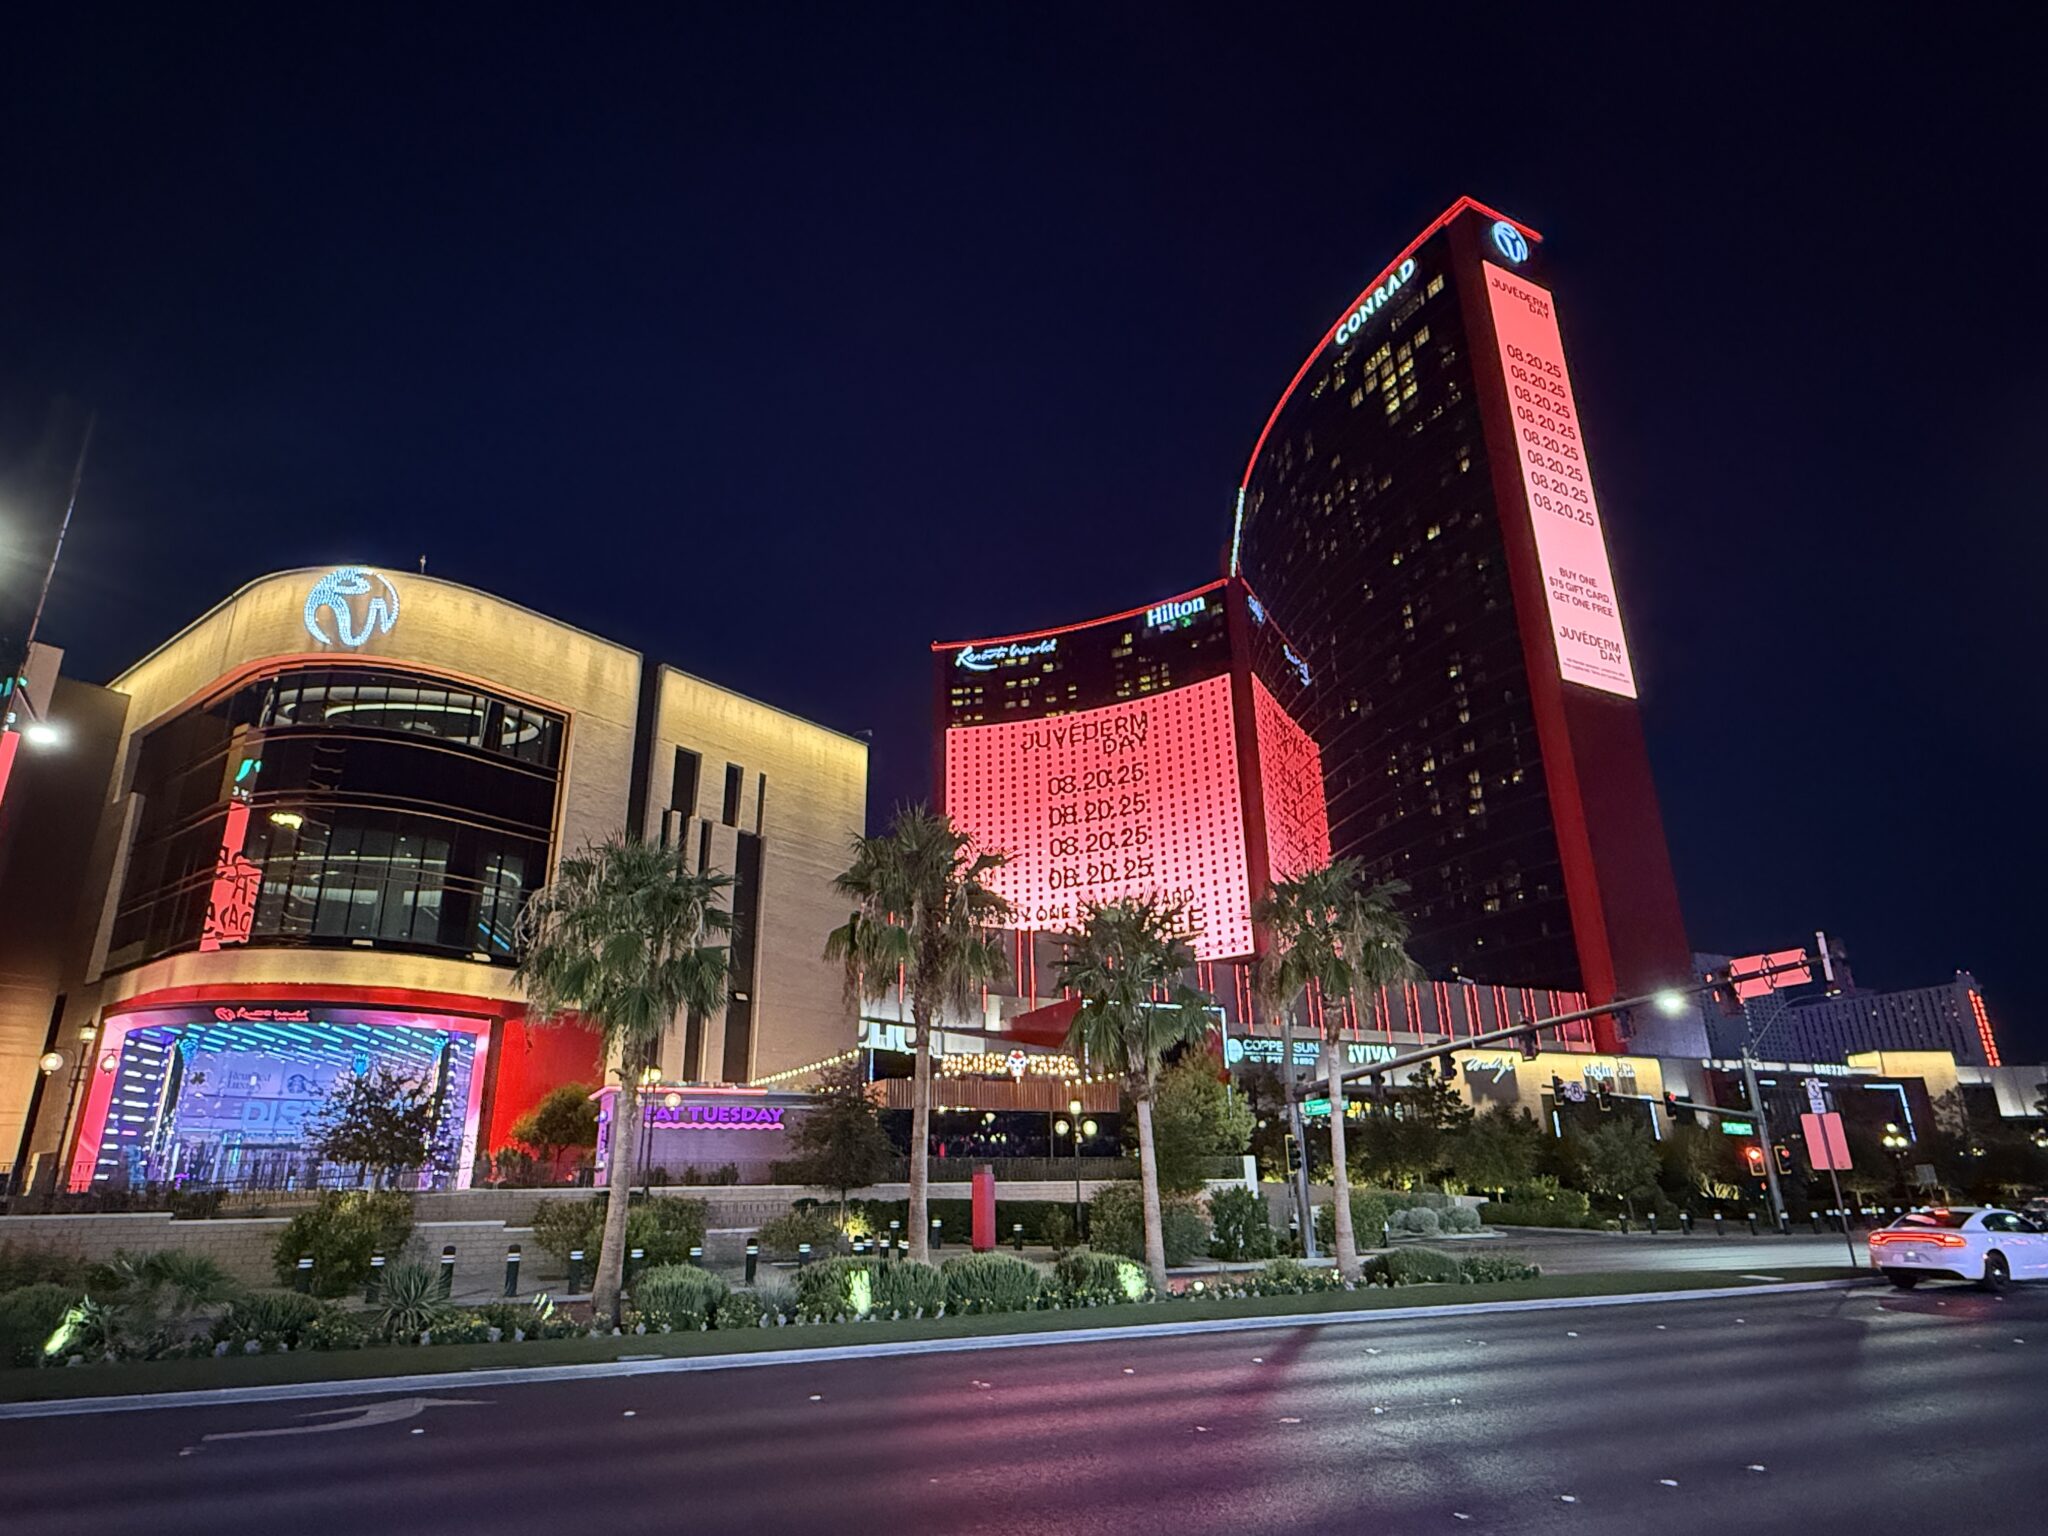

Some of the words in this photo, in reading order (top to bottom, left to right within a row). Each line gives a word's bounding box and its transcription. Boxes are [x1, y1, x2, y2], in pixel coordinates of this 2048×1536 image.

[1334, 257, 1416, 345] CONRAD
[1529, 303, 1549, 319] DAY
[1507, 344, 1562, 378] 08.20.25
[1511, 365, 1566, 398] 08.20.25
[1514, 385, 1570, 419] 08.20.25
[1517, 405, 1576, 440] 08.20.25
[1523, 428, 1579, 460] 08.20.25
[1528, 449, 1583, 482] 08.20.25
[1531, 471, 1588, 504] 08.20.25
[1534, 493, 1594, 526] 08.20.25
[1549, 576, 1564, 589] $75
[1565, 582, 1584, 596] GIFT
[1559, 567, 1577, 580] BUY
[1579, 574, 1598, 588] ONE
[1146, 595, 1206, 628] Hilton
[1553, 590, 1570, 604] GET
[1572, 597, 1591, 611] ONE
[1592, 603, 1614, 618] FREE
[955, 645, 1008, 670] Resorts
[1009, 638, 1058, 658] World
[1559, 626, 1622, 654] JUVÉDERM
[1600, 649, 1622, 664] DAY
[1103, 729, 1148, 756] DAY
[1048, 763, 1144, 796] 08.20.25
[1049, 793, 1146, 827] 08.20.25
[1050, 825, 1148, 858] 08.20.25
[1049, 857, 1152, 890] 08.20.25
[1243, 1038, 1285, 1053] COPPE
[1292, 1041, 1320, 1054] SUN
[688, 1106, 785, 1122] TUESDAY
